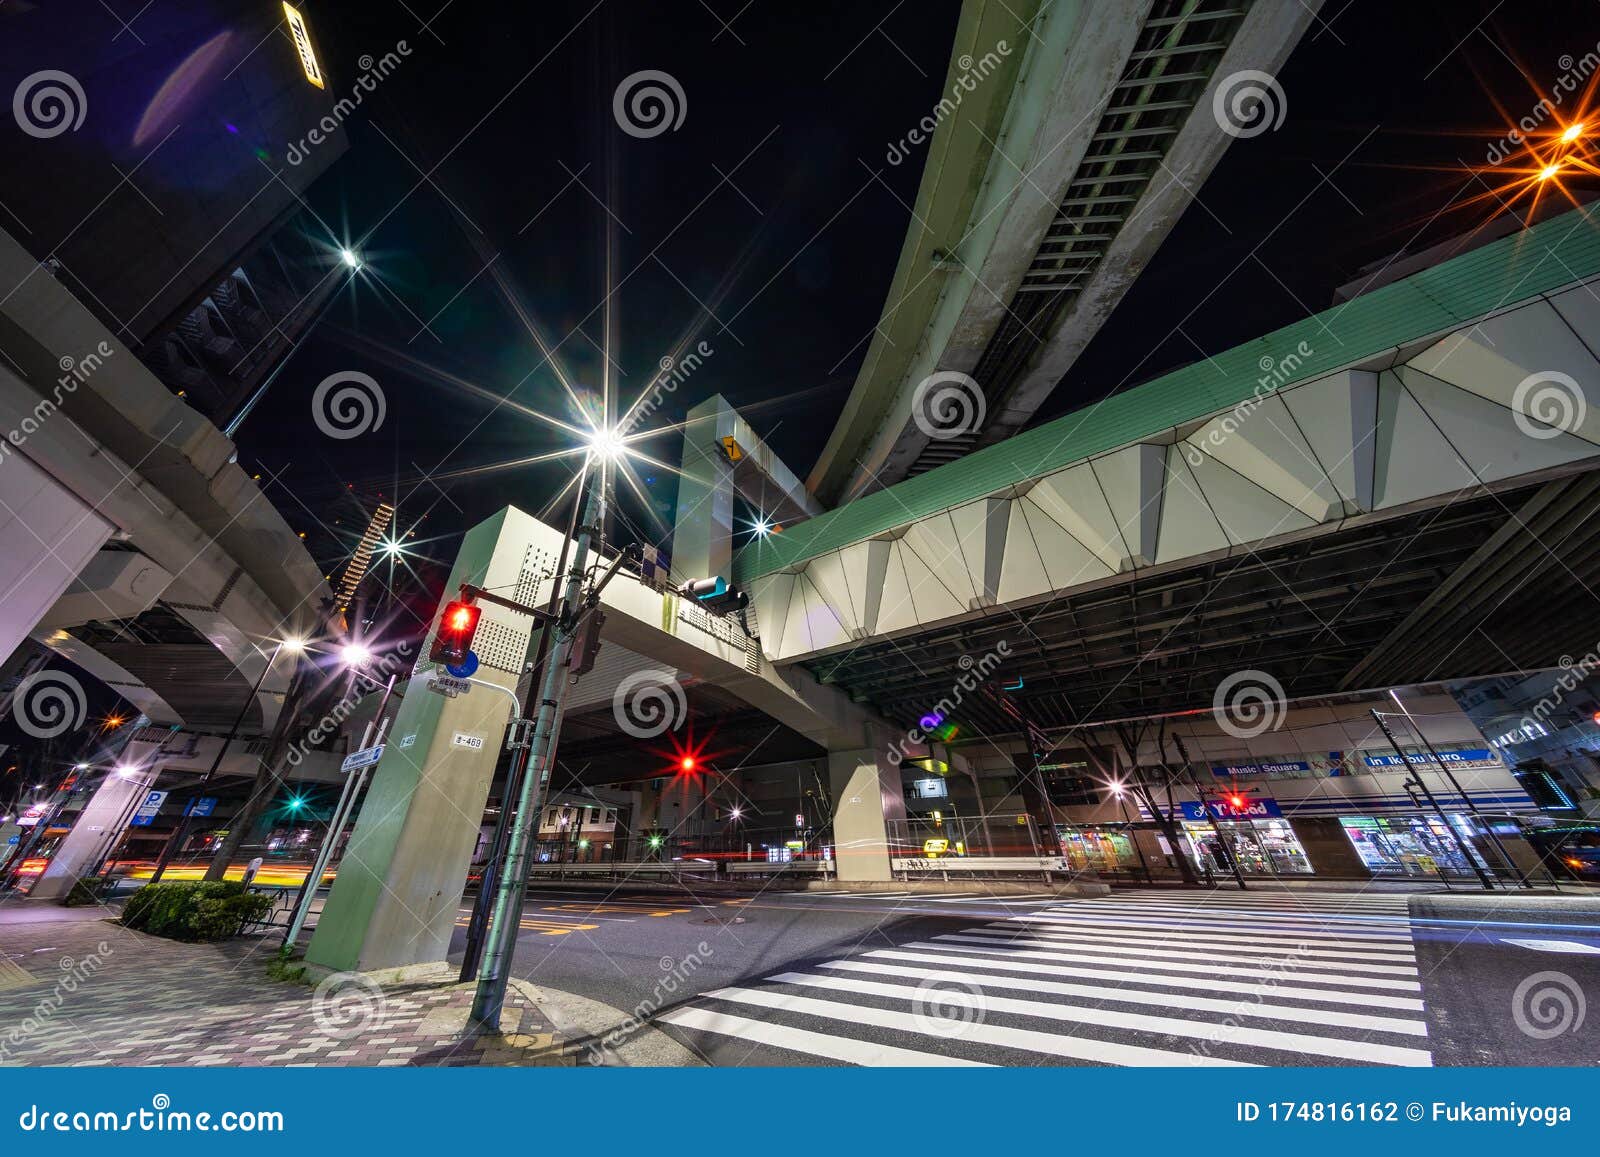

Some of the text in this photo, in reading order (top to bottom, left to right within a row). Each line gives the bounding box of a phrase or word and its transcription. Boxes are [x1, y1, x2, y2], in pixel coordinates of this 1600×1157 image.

[1388, 755, 1425, 765] Ikbu
[1227, 766, 1257, 775] Music
[1262, 763, 1300, 773] Square
[145, 793, 161, 805] P
